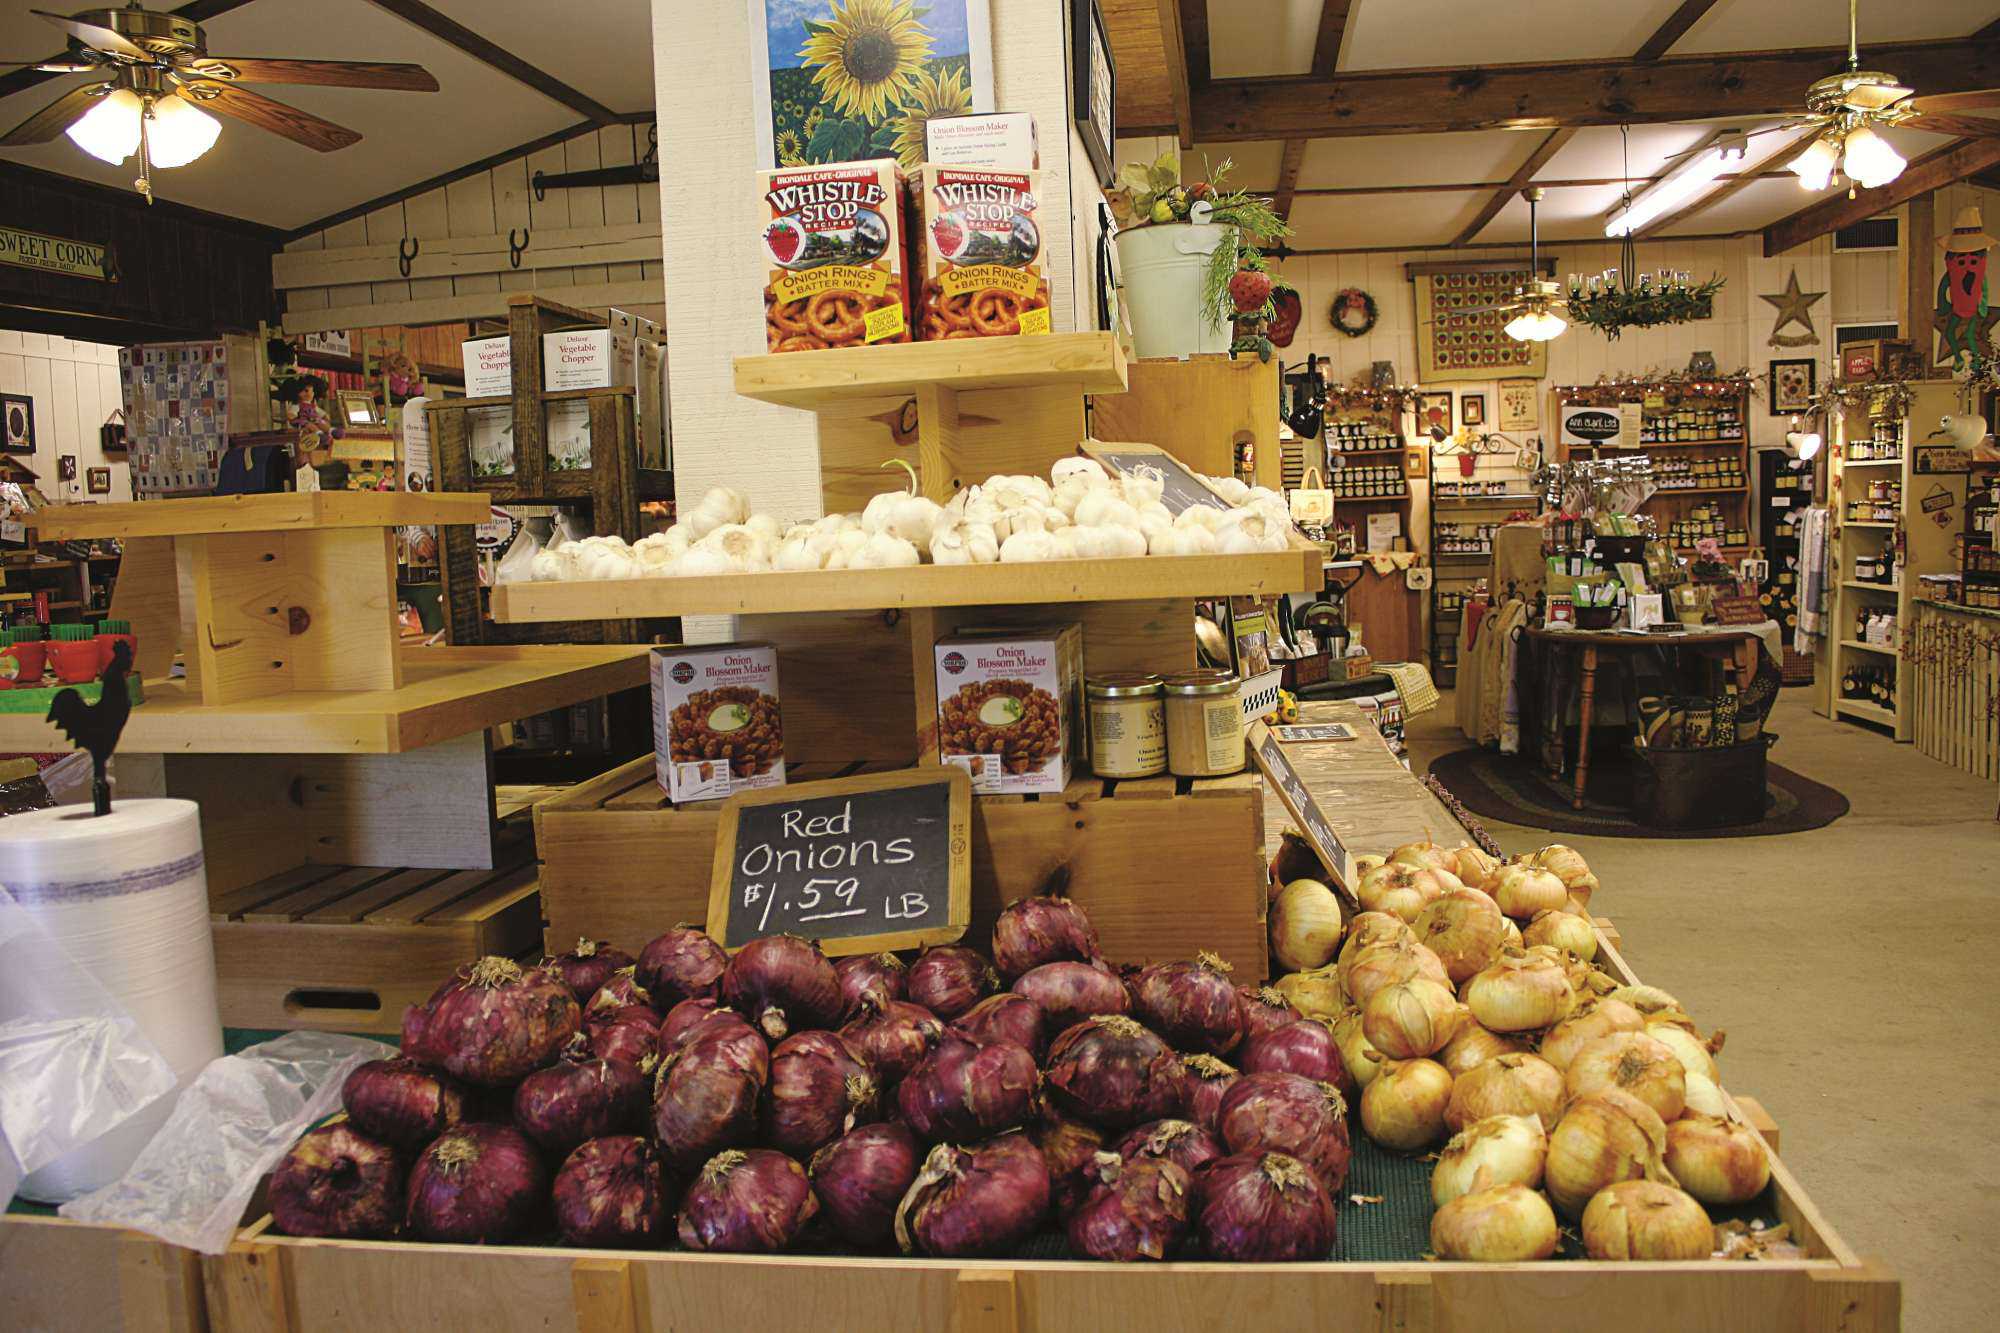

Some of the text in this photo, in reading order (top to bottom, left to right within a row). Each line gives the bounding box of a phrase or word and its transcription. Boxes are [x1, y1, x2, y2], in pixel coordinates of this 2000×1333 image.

[986, 122, 1009, 130] Maker
[777, 173, 812, 184] IRONDALE
[801, 201, 858, 223] STOP
[966, 203, 1014, 221] STOP
[805, 221, 854, 229] RECIPES
[0, 231, 97, 267] SWEET CORN
[783, 267, 876, 288] ONION RINGS
[949, 266, 1029, 284] ONION RINGS
[796, 279, 863, 294] BATTER MIX
[961, 278, 1018, 289] BATTER MIX
[484, 342, 505, 350] Deluxe
[559, 344, 596, 354] Vegetable
[478, 351, 511, 362] Vegetabl
[561, 354, 594, 364] Chopper
[480, 361, 511, 371] Choppe
[996, 646, 1025, 658] Onion
[724, 654, 752, 666] Onion
[977, 655, 1047, 669] Blossom Maker
[705, 663, 771, 678] Blossom Maker
[781, 800, 851, 838] Red
[741, 838, 915, 876] Onions
[884, 893, 929, 919] LB
